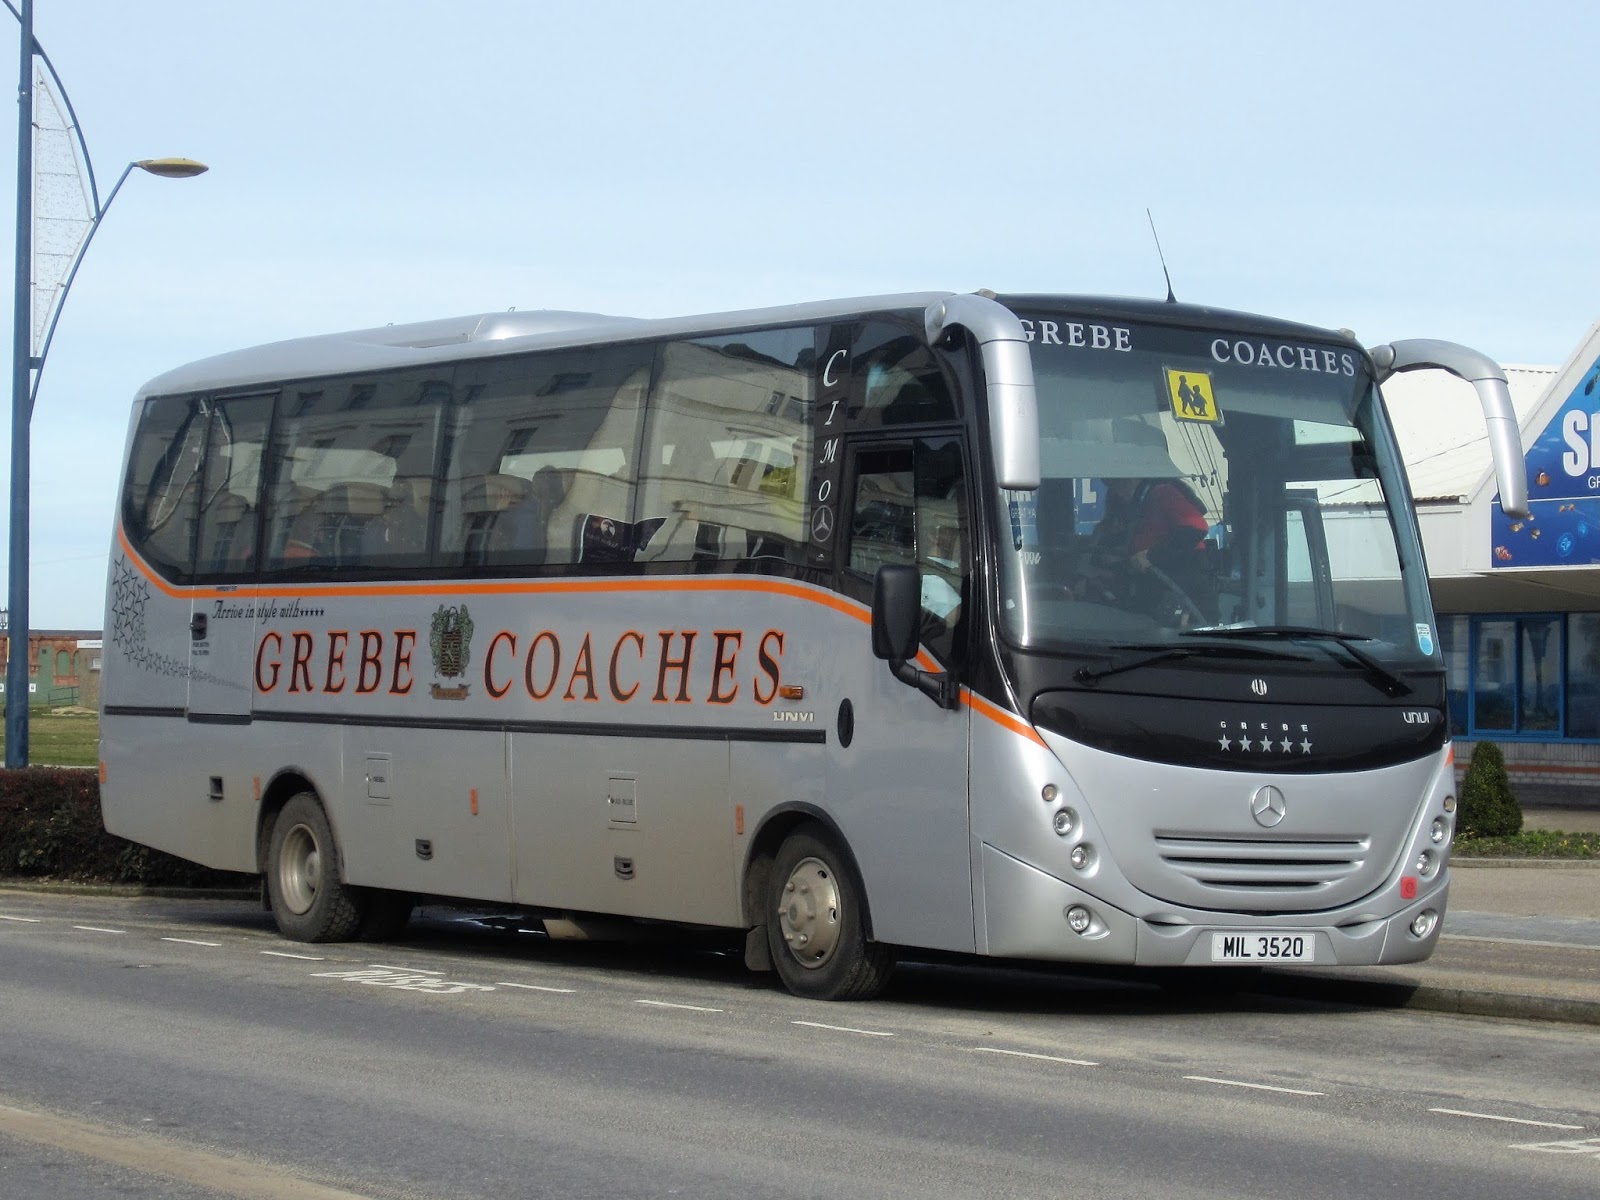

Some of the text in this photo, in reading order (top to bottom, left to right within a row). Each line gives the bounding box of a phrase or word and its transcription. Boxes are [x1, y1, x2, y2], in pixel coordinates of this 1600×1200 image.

[1018, 319, 1356, 377] GREBE COACHES
[212, 598, 300, 625] Arrive in style with
[254, 628, 786, 707] GREBE COACHES
[773, 710, 815, 723] UNVI
[1220, 720, 1309, 733] GREBE
[1222, 936, 1304, 958] MIL 3520
